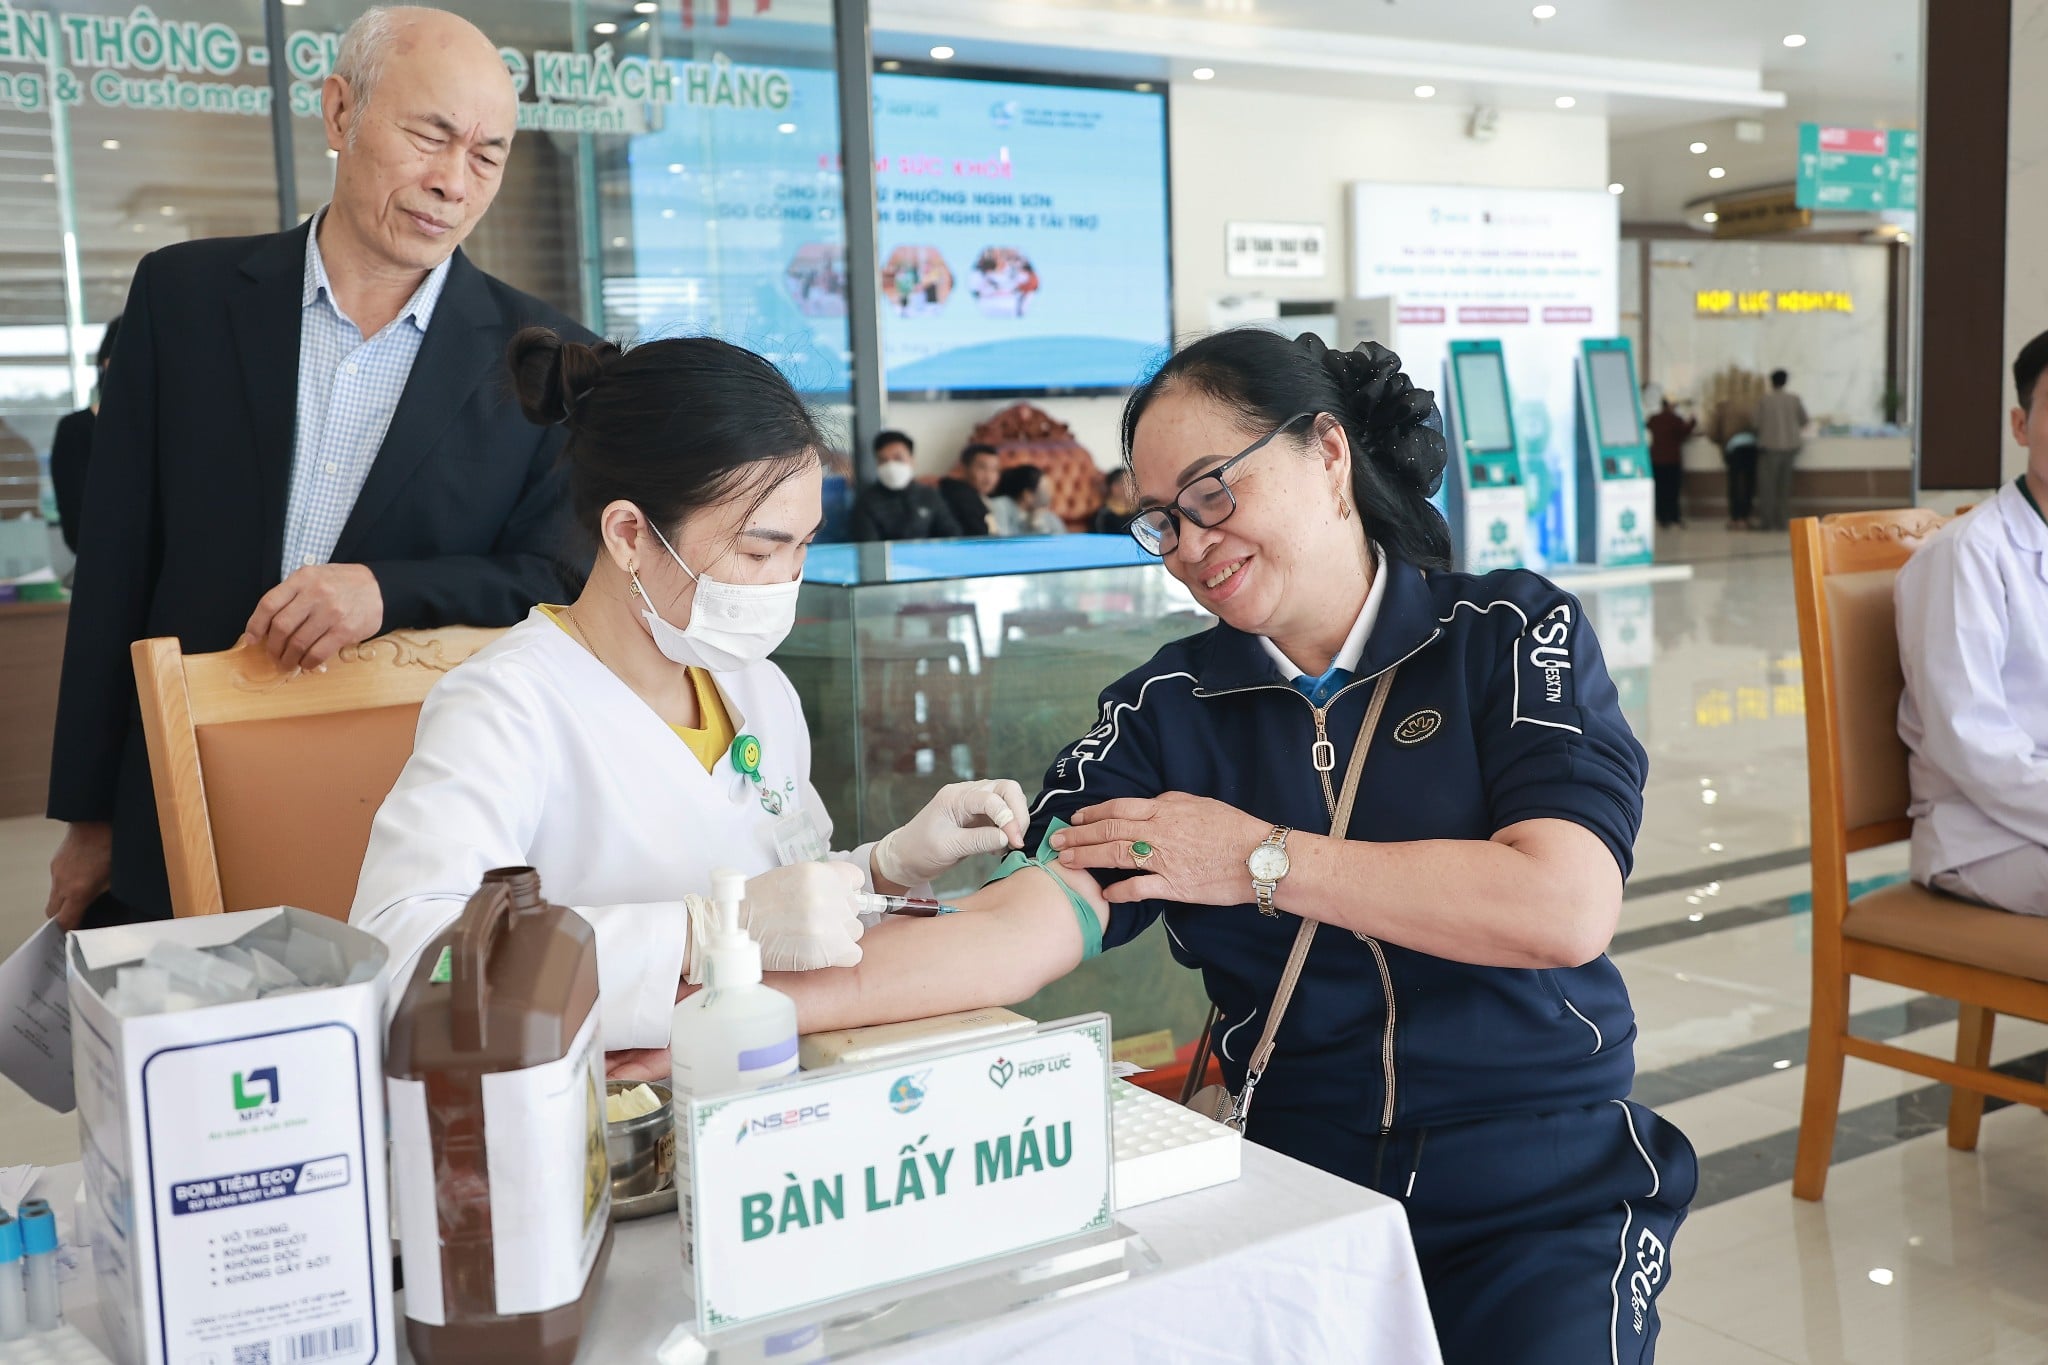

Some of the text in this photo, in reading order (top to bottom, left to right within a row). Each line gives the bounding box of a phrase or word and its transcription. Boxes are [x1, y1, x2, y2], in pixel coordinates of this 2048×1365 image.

[67, 10, 237, 71] THÔNG
[541, 48, 672, 100] KHÁCH
[688, 55, 789, 110] HÀNG
[57, 73, 79, 100] &
[96, 73, 271, 113] Customer
[751, 1103, 830, 1132] NS2PC
[260, 1168, 297, 1186] ECO
[741, 1116, 1073, 1243] BÀN LẤY MÁU
